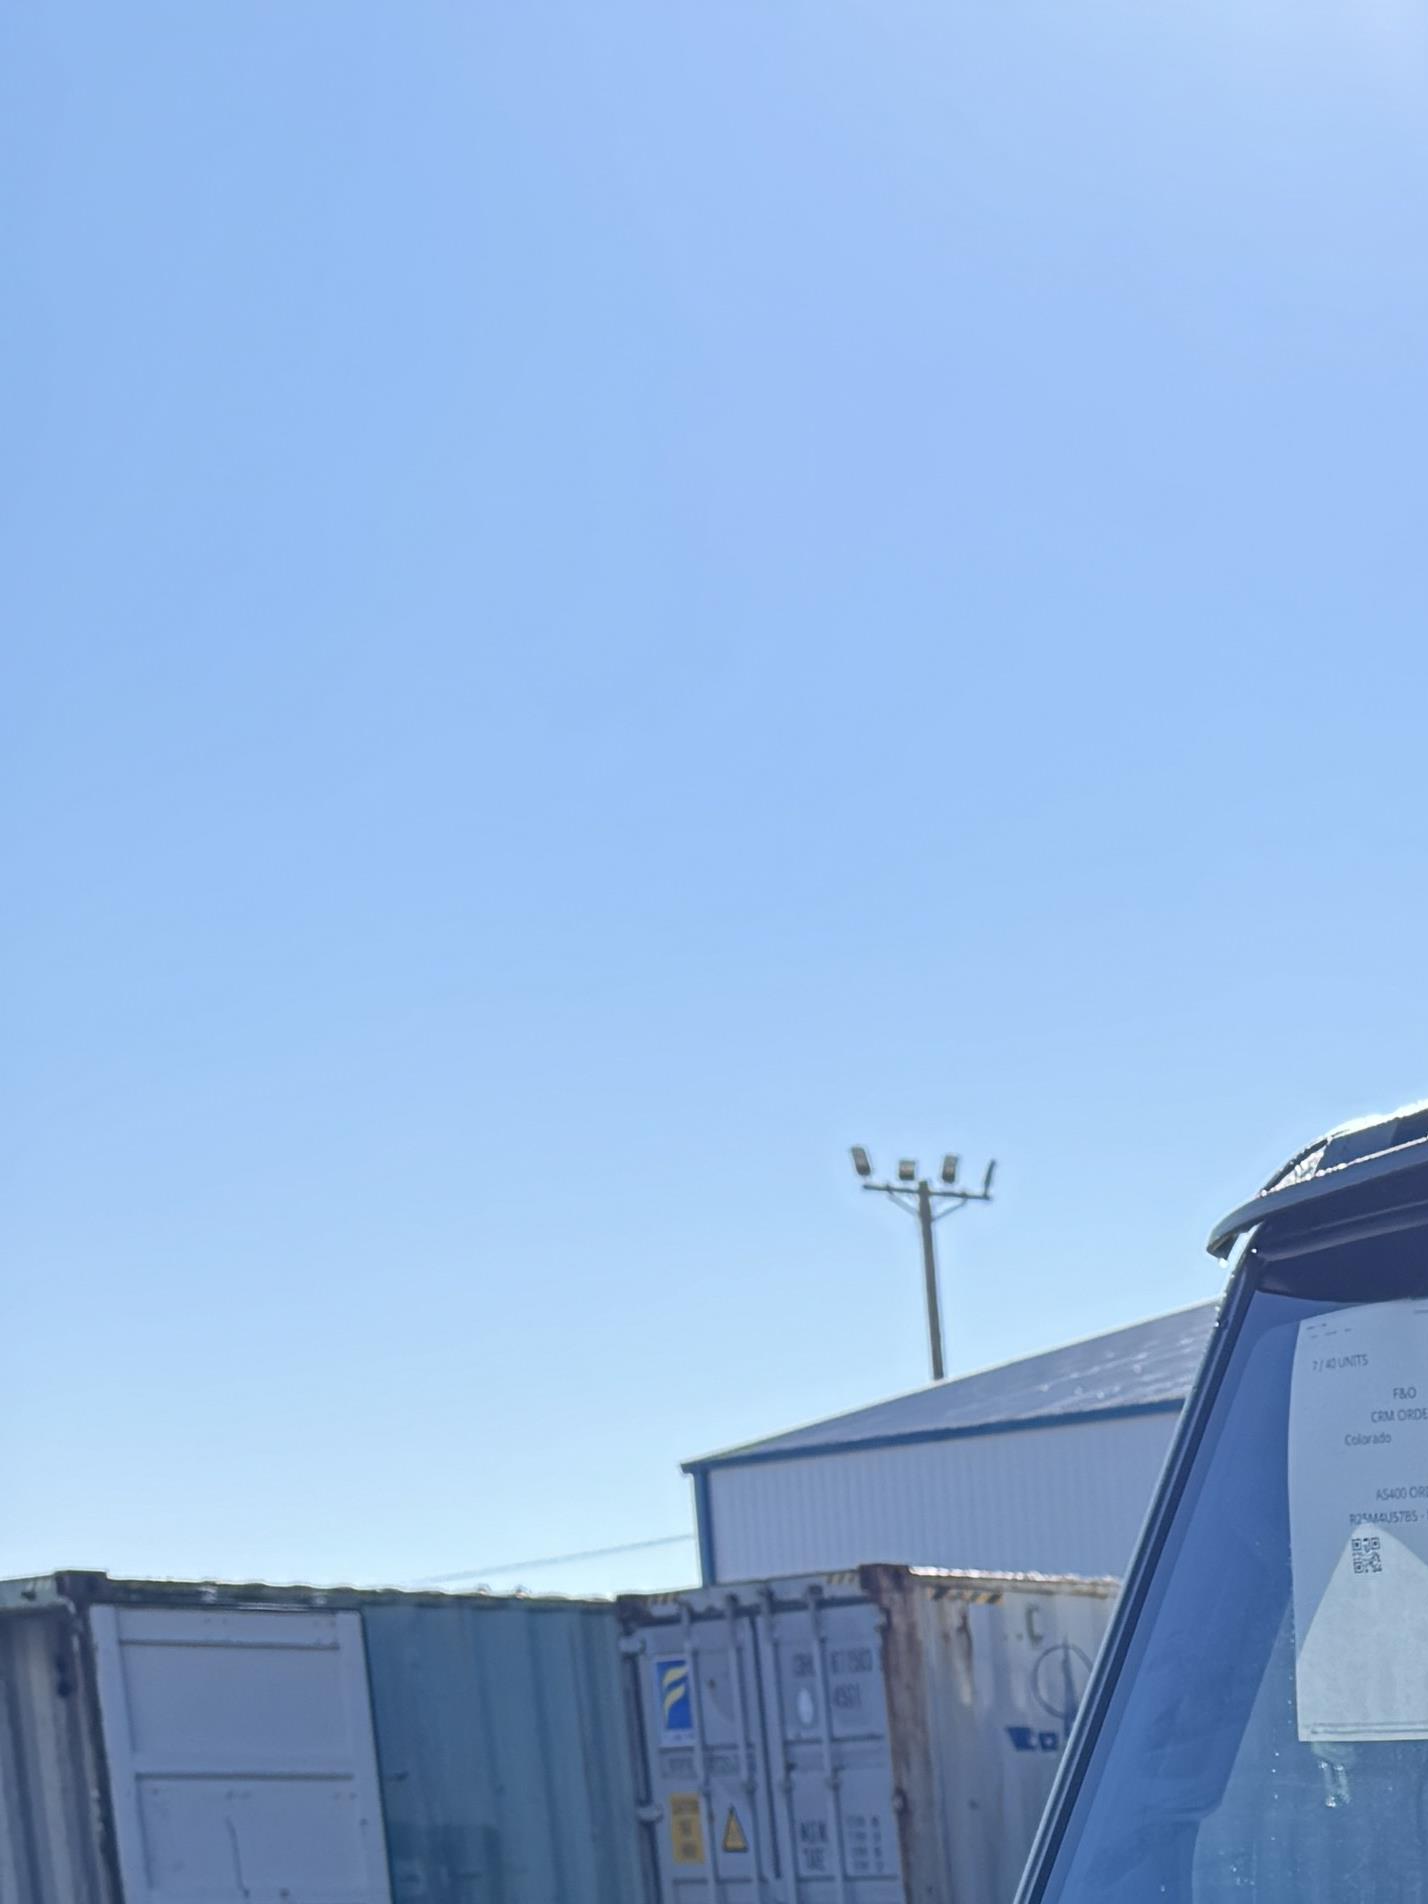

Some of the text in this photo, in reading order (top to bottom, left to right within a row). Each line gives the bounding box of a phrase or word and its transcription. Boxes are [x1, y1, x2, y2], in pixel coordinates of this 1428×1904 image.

[1337, 1354, 1369, 1369] UNITS
[1393, 1386, 1417, 1400] F&O
[1370, 1409, 1396, 1424] CRM
[1344, 1432, 1392, 1446] Colorado
